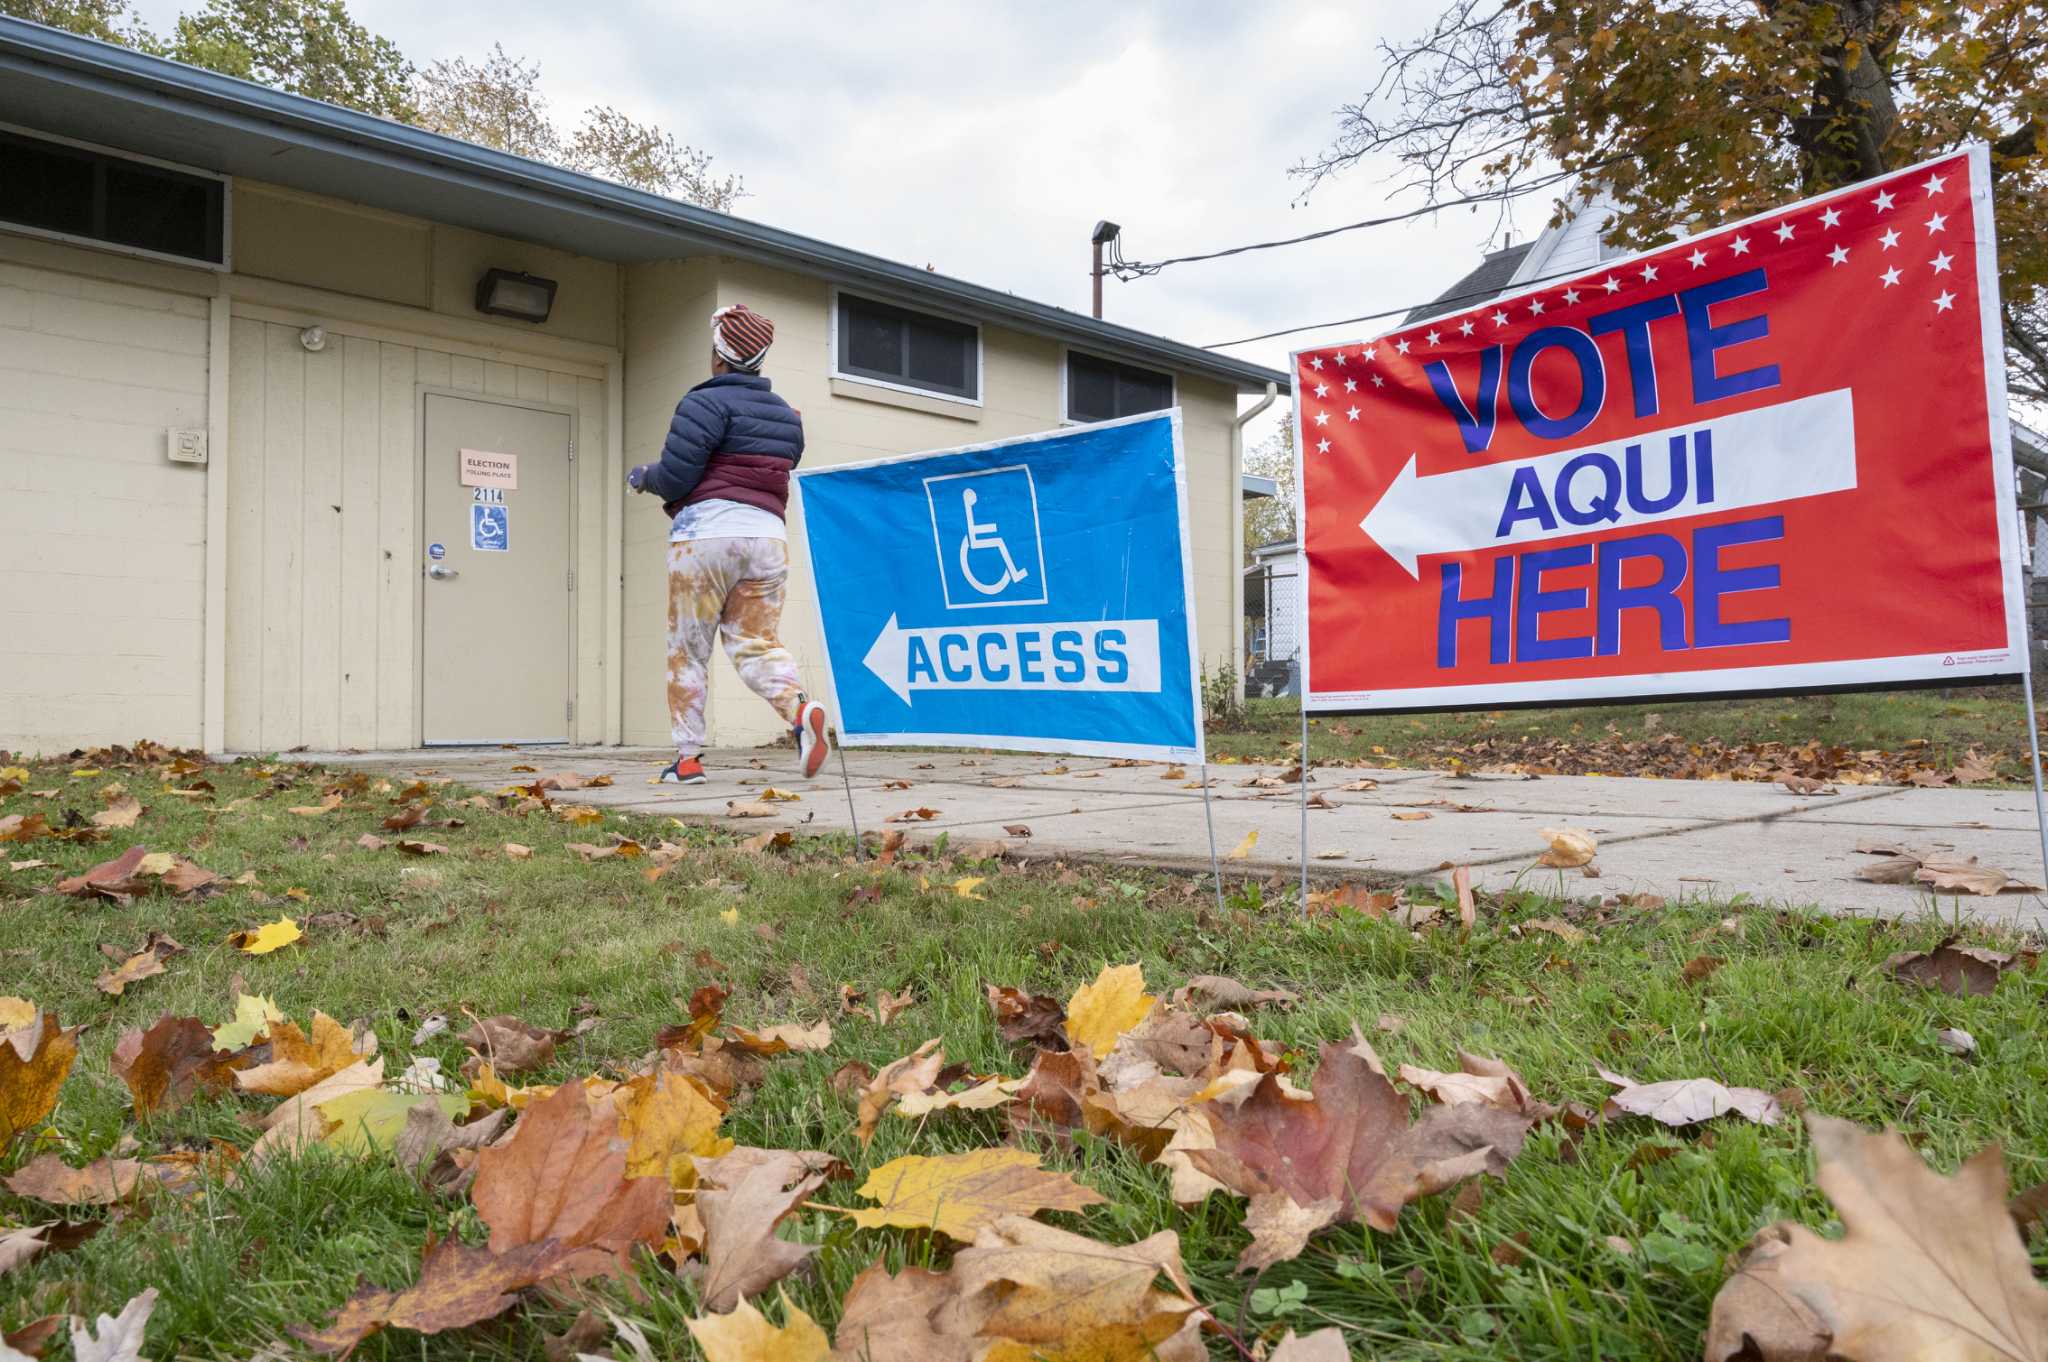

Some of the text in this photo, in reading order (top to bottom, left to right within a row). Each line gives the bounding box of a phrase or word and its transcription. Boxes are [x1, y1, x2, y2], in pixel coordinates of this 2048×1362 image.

[1423, 268, 1781, 454] VOTE
[467, 458, 510, 469] ELECTION
[474, 487, 503, 502] 2114
[1496, 429, 1714, 537] AQUI
[1437, 515, 1791, 668] HERE
[907, 629, 1129, 683] ACCESS
